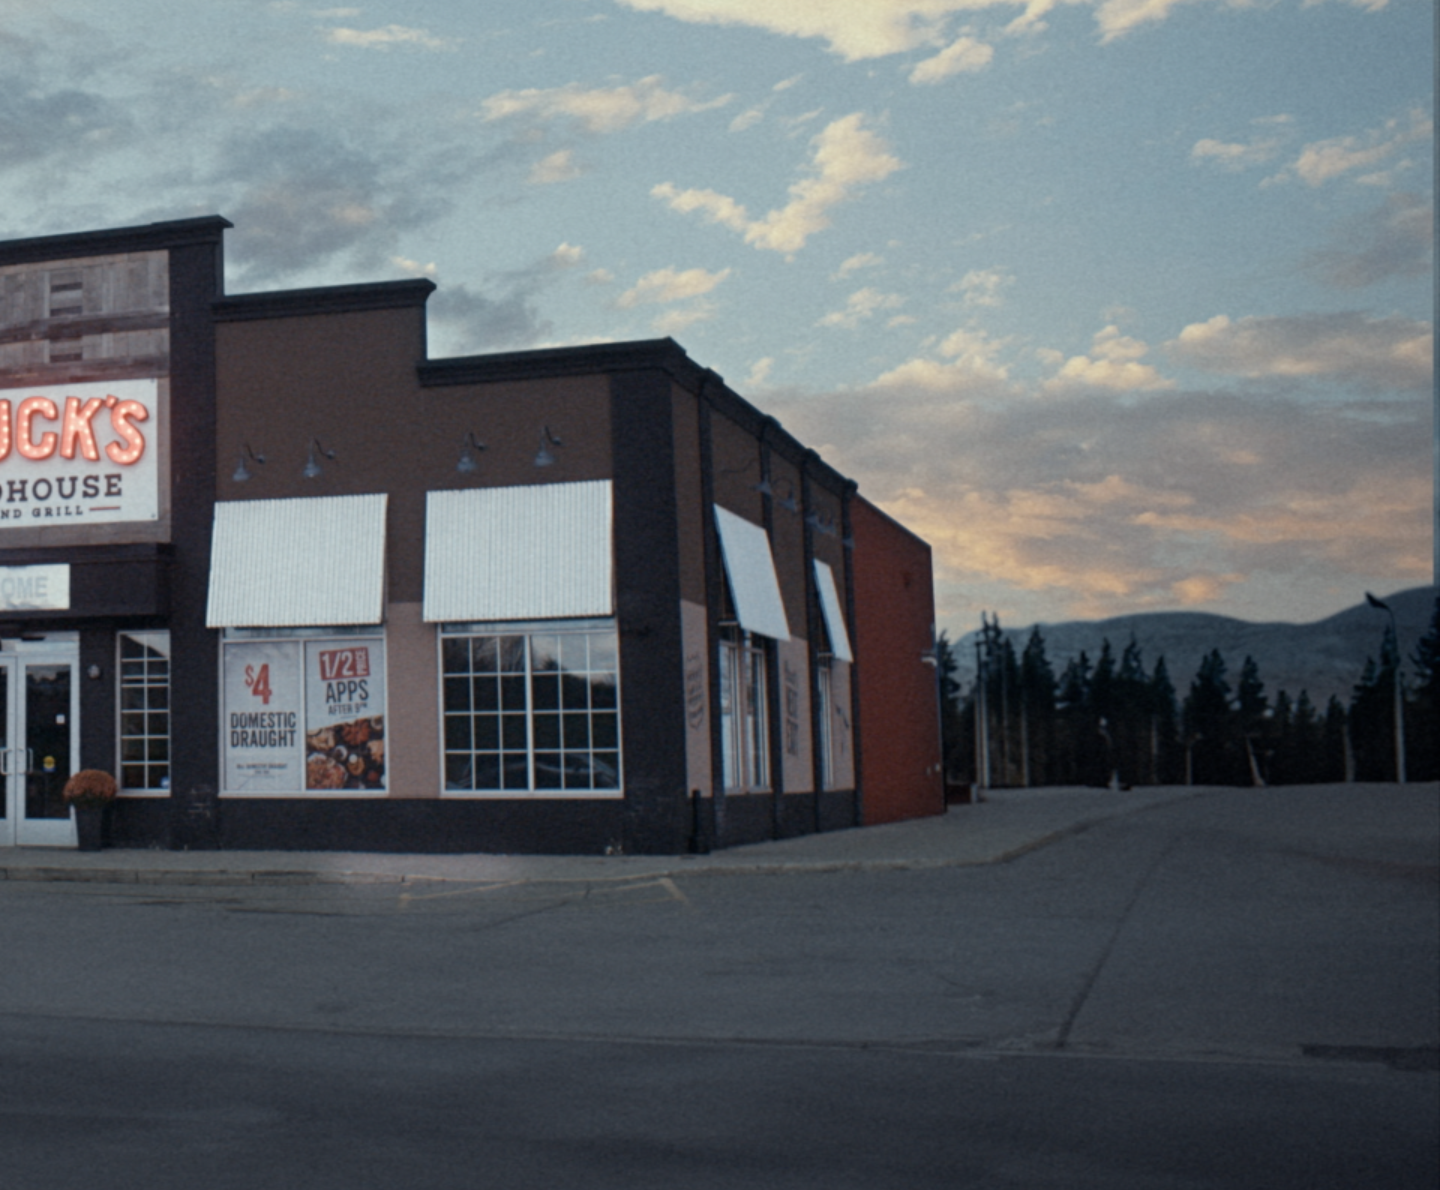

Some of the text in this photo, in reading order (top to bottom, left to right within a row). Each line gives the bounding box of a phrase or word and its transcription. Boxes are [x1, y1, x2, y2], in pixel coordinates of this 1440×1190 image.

[32, 505, 83, 518] GRILL
[321, 650, 354, 679] 1/2
[244, 663, 273, 705] $4
[326, 679, 369, 704] APPS
[230, 712, 296, 729] DOMESTIC
[230, 729, 296, 748] DRAUGHT
